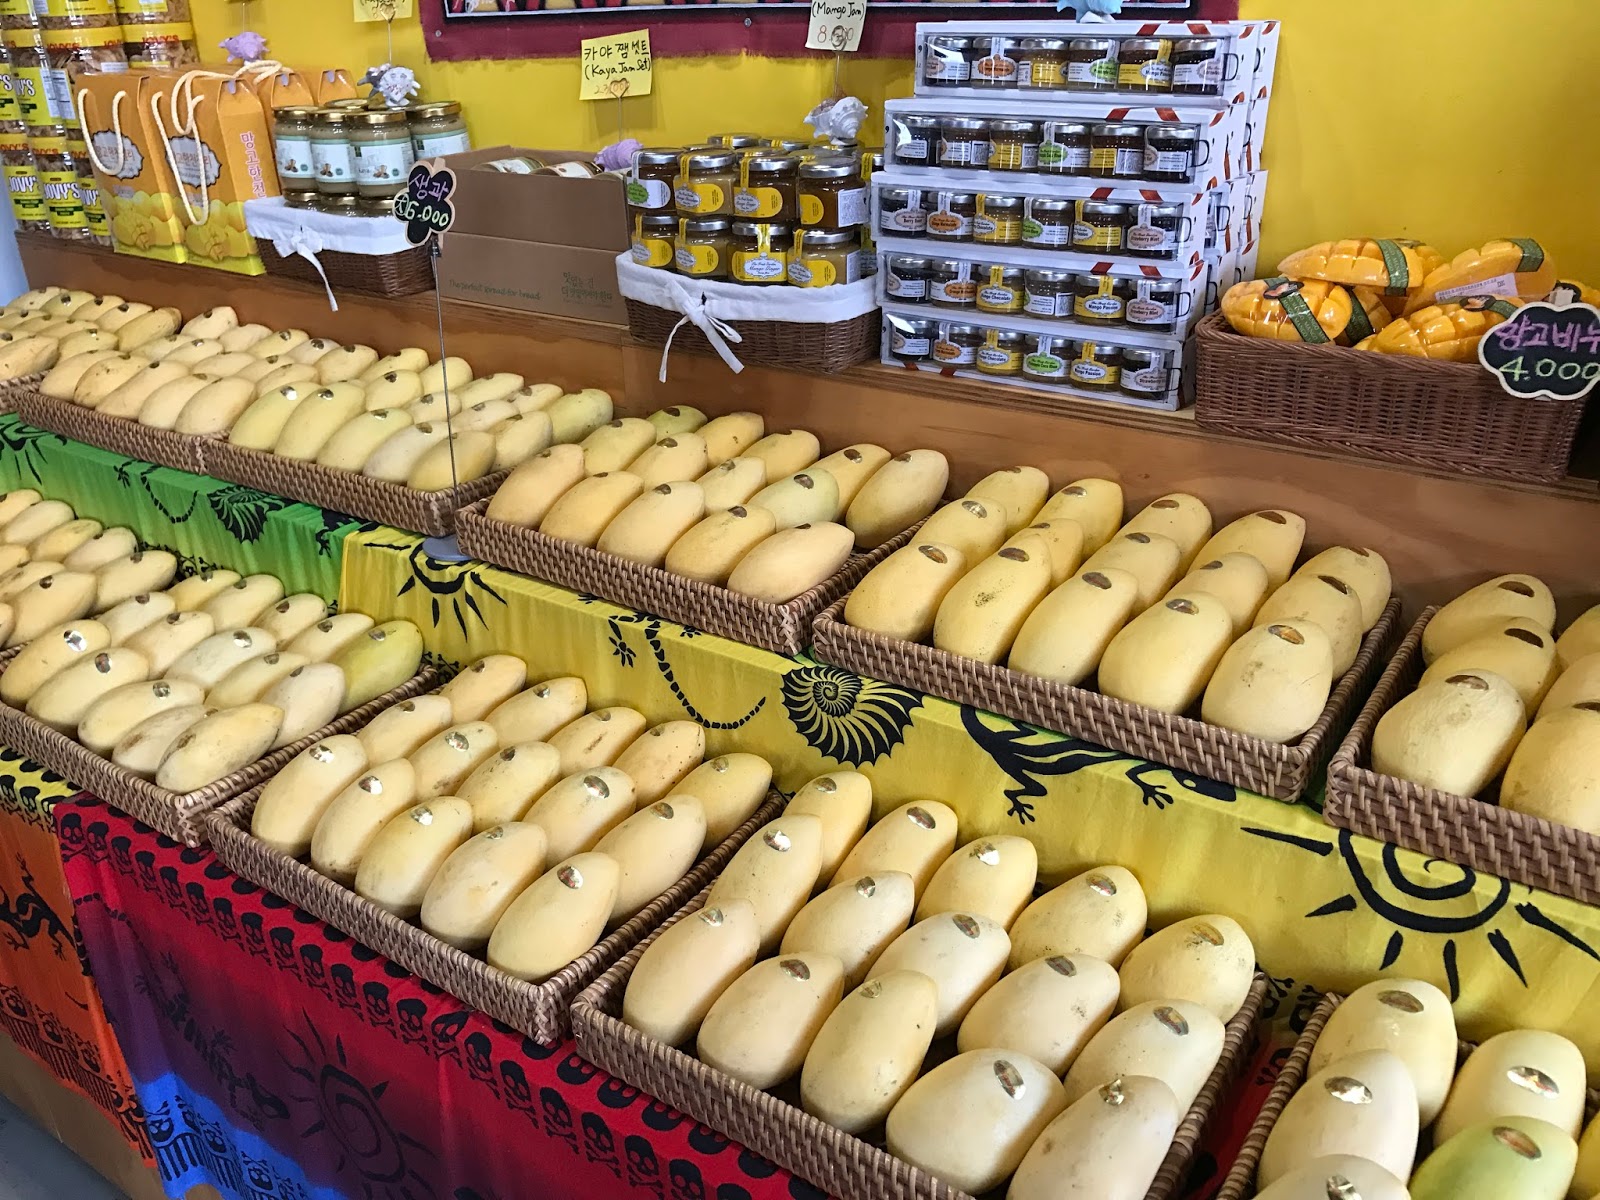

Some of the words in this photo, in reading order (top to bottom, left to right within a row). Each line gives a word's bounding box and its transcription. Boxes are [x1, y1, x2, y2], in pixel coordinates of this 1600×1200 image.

[812, 1, 846, 19] (Mango
[847, 2, 864, 20] Jam)
[584, 64, 617, 80] (Kaya
[618, 61, 635, 73] Jam
[44, 182, 81, 200] JOVY'S
[408, 174, 449, 202] 생과
[1499, 356, 1600, 381] 4.000
